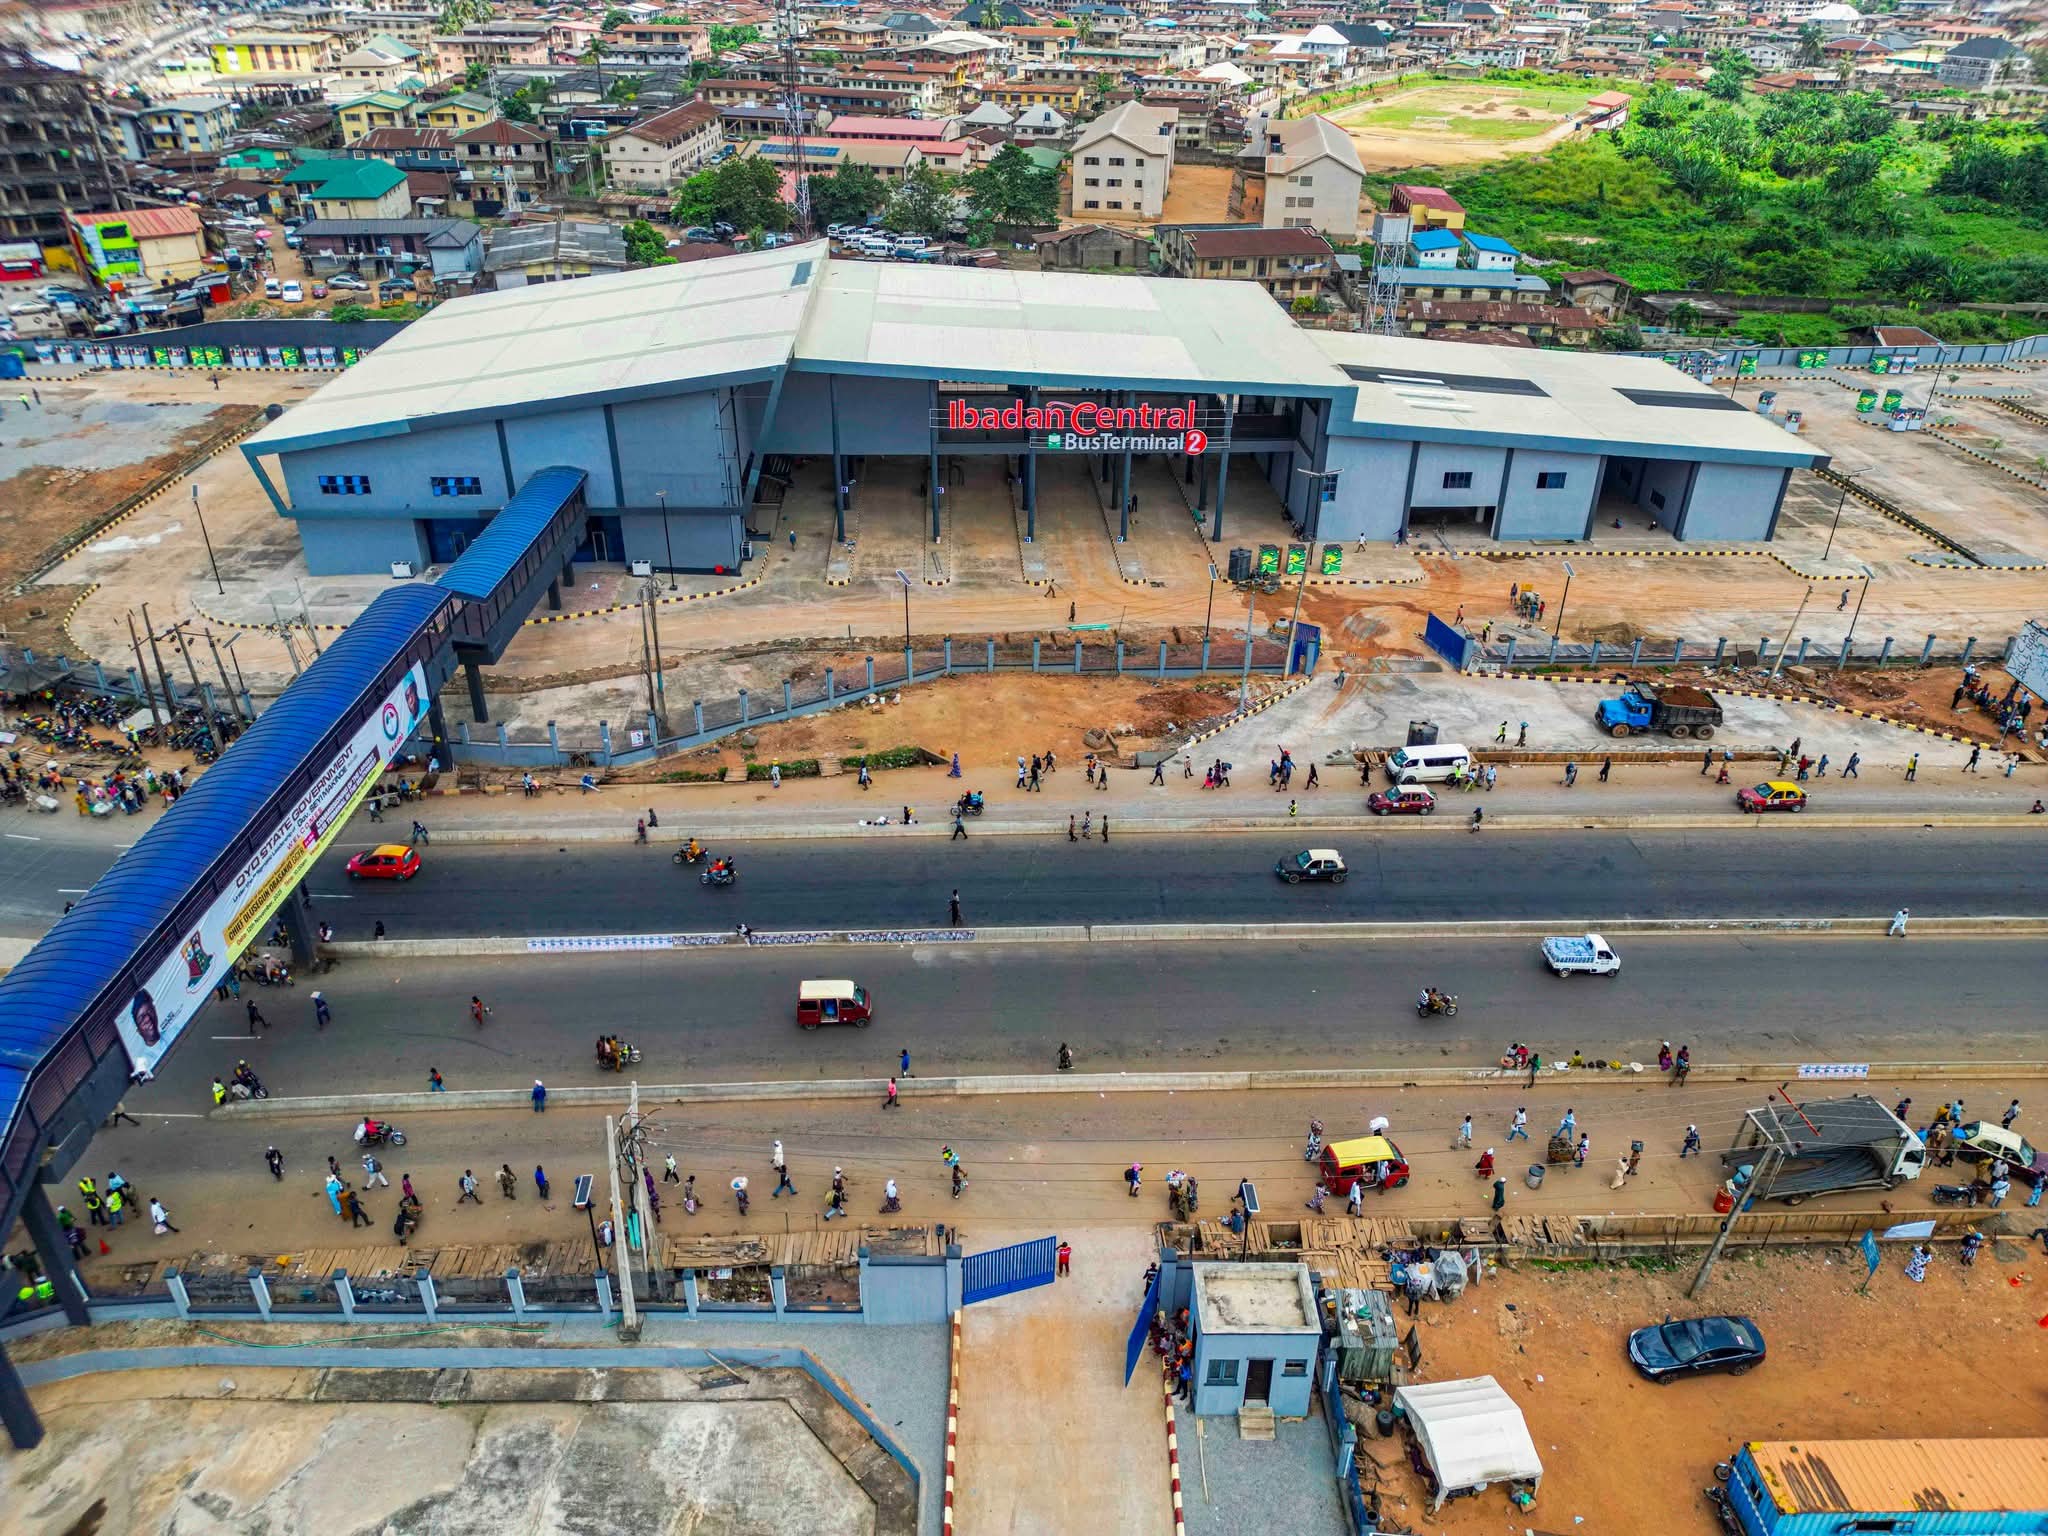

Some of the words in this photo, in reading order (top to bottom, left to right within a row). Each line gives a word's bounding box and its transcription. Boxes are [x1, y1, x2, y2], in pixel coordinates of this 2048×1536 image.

[949, 399, 1064, 430] Ibadan
[1070, 400, 1196, 435] Central
[309, 795, 323, 812] SEYI
[322, 766, 347, 796] MAKINDE
[236, 856, 260, 888] OYO
[260, 816, 292, 859] STATE
[292, 743, 353, 820] GOVERNMENT
[287, 807, 323, 850] WELCOMES
[229, 919, 244, 941] CHIEF
[243, 889, 270, 922] OLUSEGUN
[269, 860, 293, 892] OBASANJO
